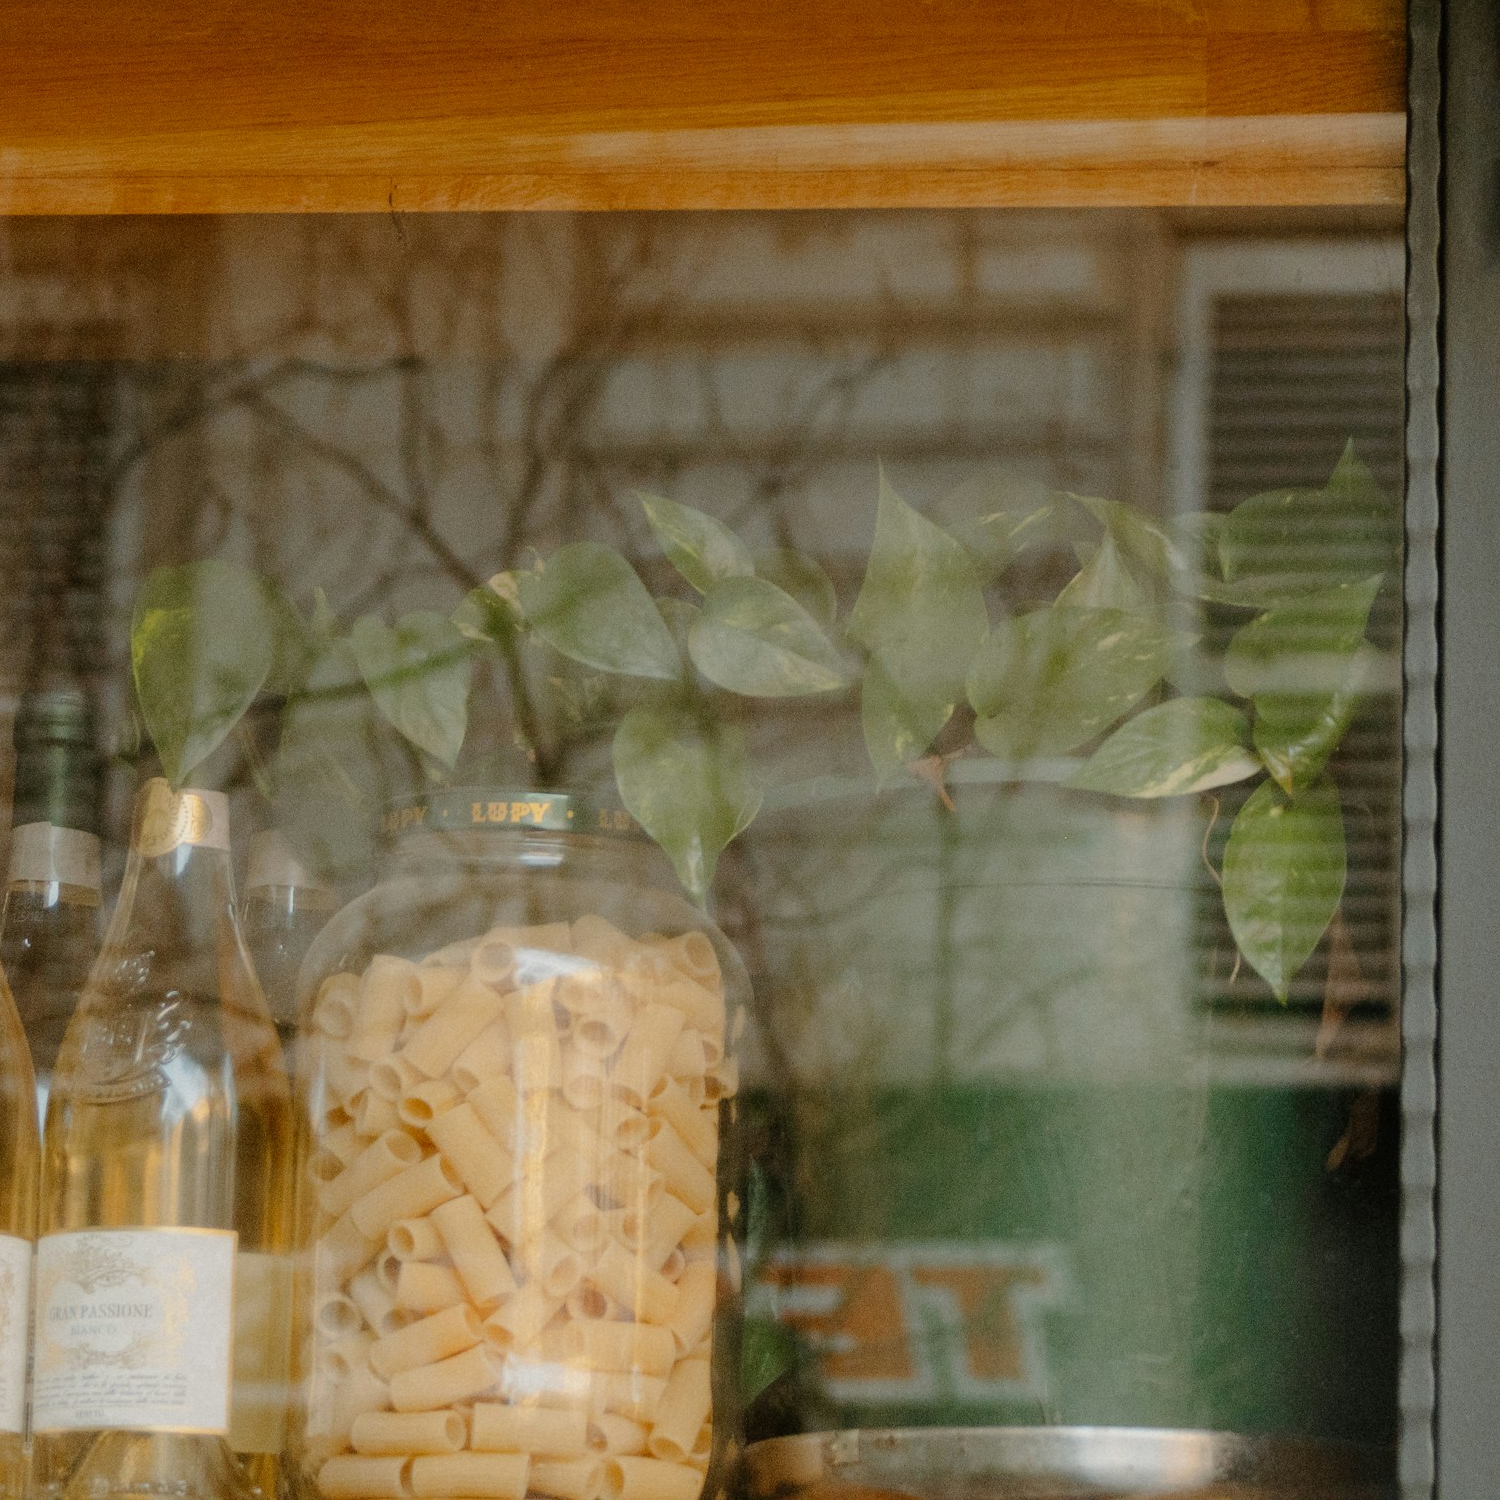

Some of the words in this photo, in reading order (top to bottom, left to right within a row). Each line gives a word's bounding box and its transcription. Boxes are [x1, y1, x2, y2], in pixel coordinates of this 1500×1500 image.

[471, 801, 551, 824] LUPY
[598, 808, 630, 830] LU
[80, 1303, 153, 1319] PASSIONE
